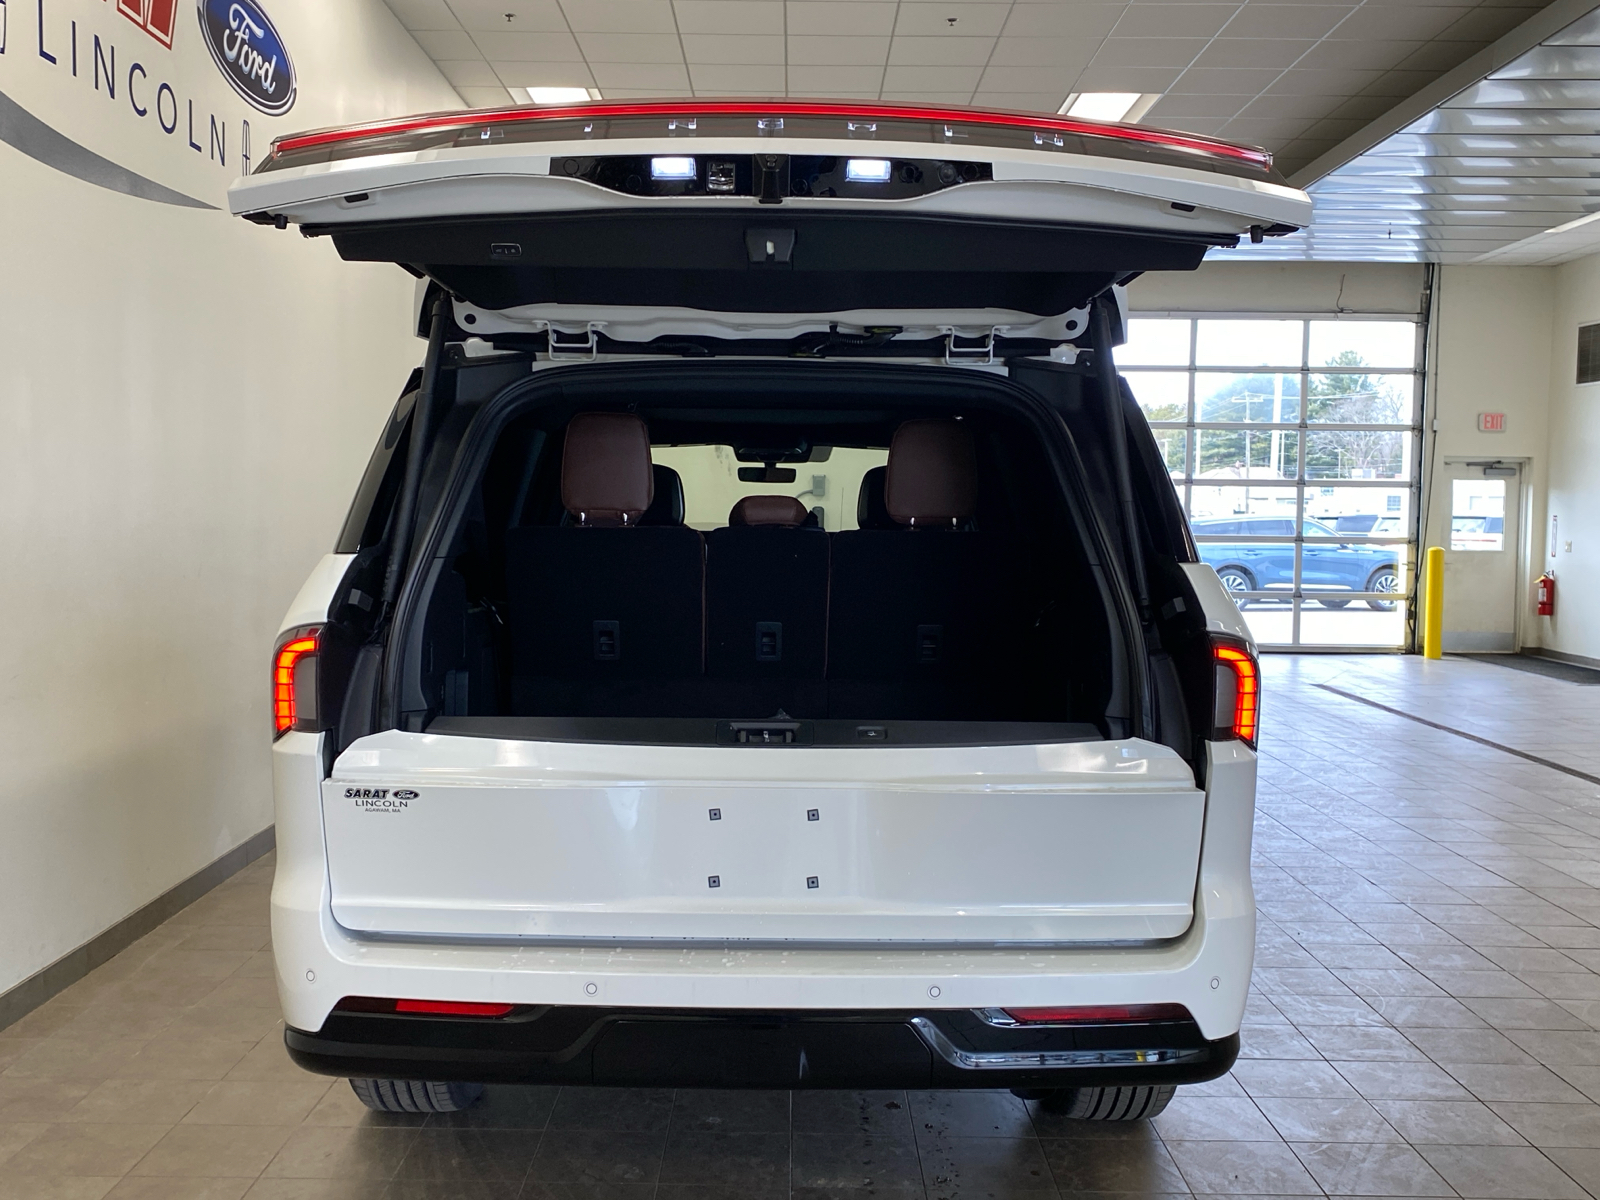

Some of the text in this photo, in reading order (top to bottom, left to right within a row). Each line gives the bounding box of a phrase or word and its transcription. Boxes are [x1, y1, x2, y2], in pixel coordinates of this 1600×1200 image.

[223, 3, 277, 94] Ford
[38, 0, 225, 167] LINCOLN
[1483, 413, 1504, 430] EXIT
[344, 788, 416, 799] SARAT Ford
[355, 800, 408, 808] LINCOLN
